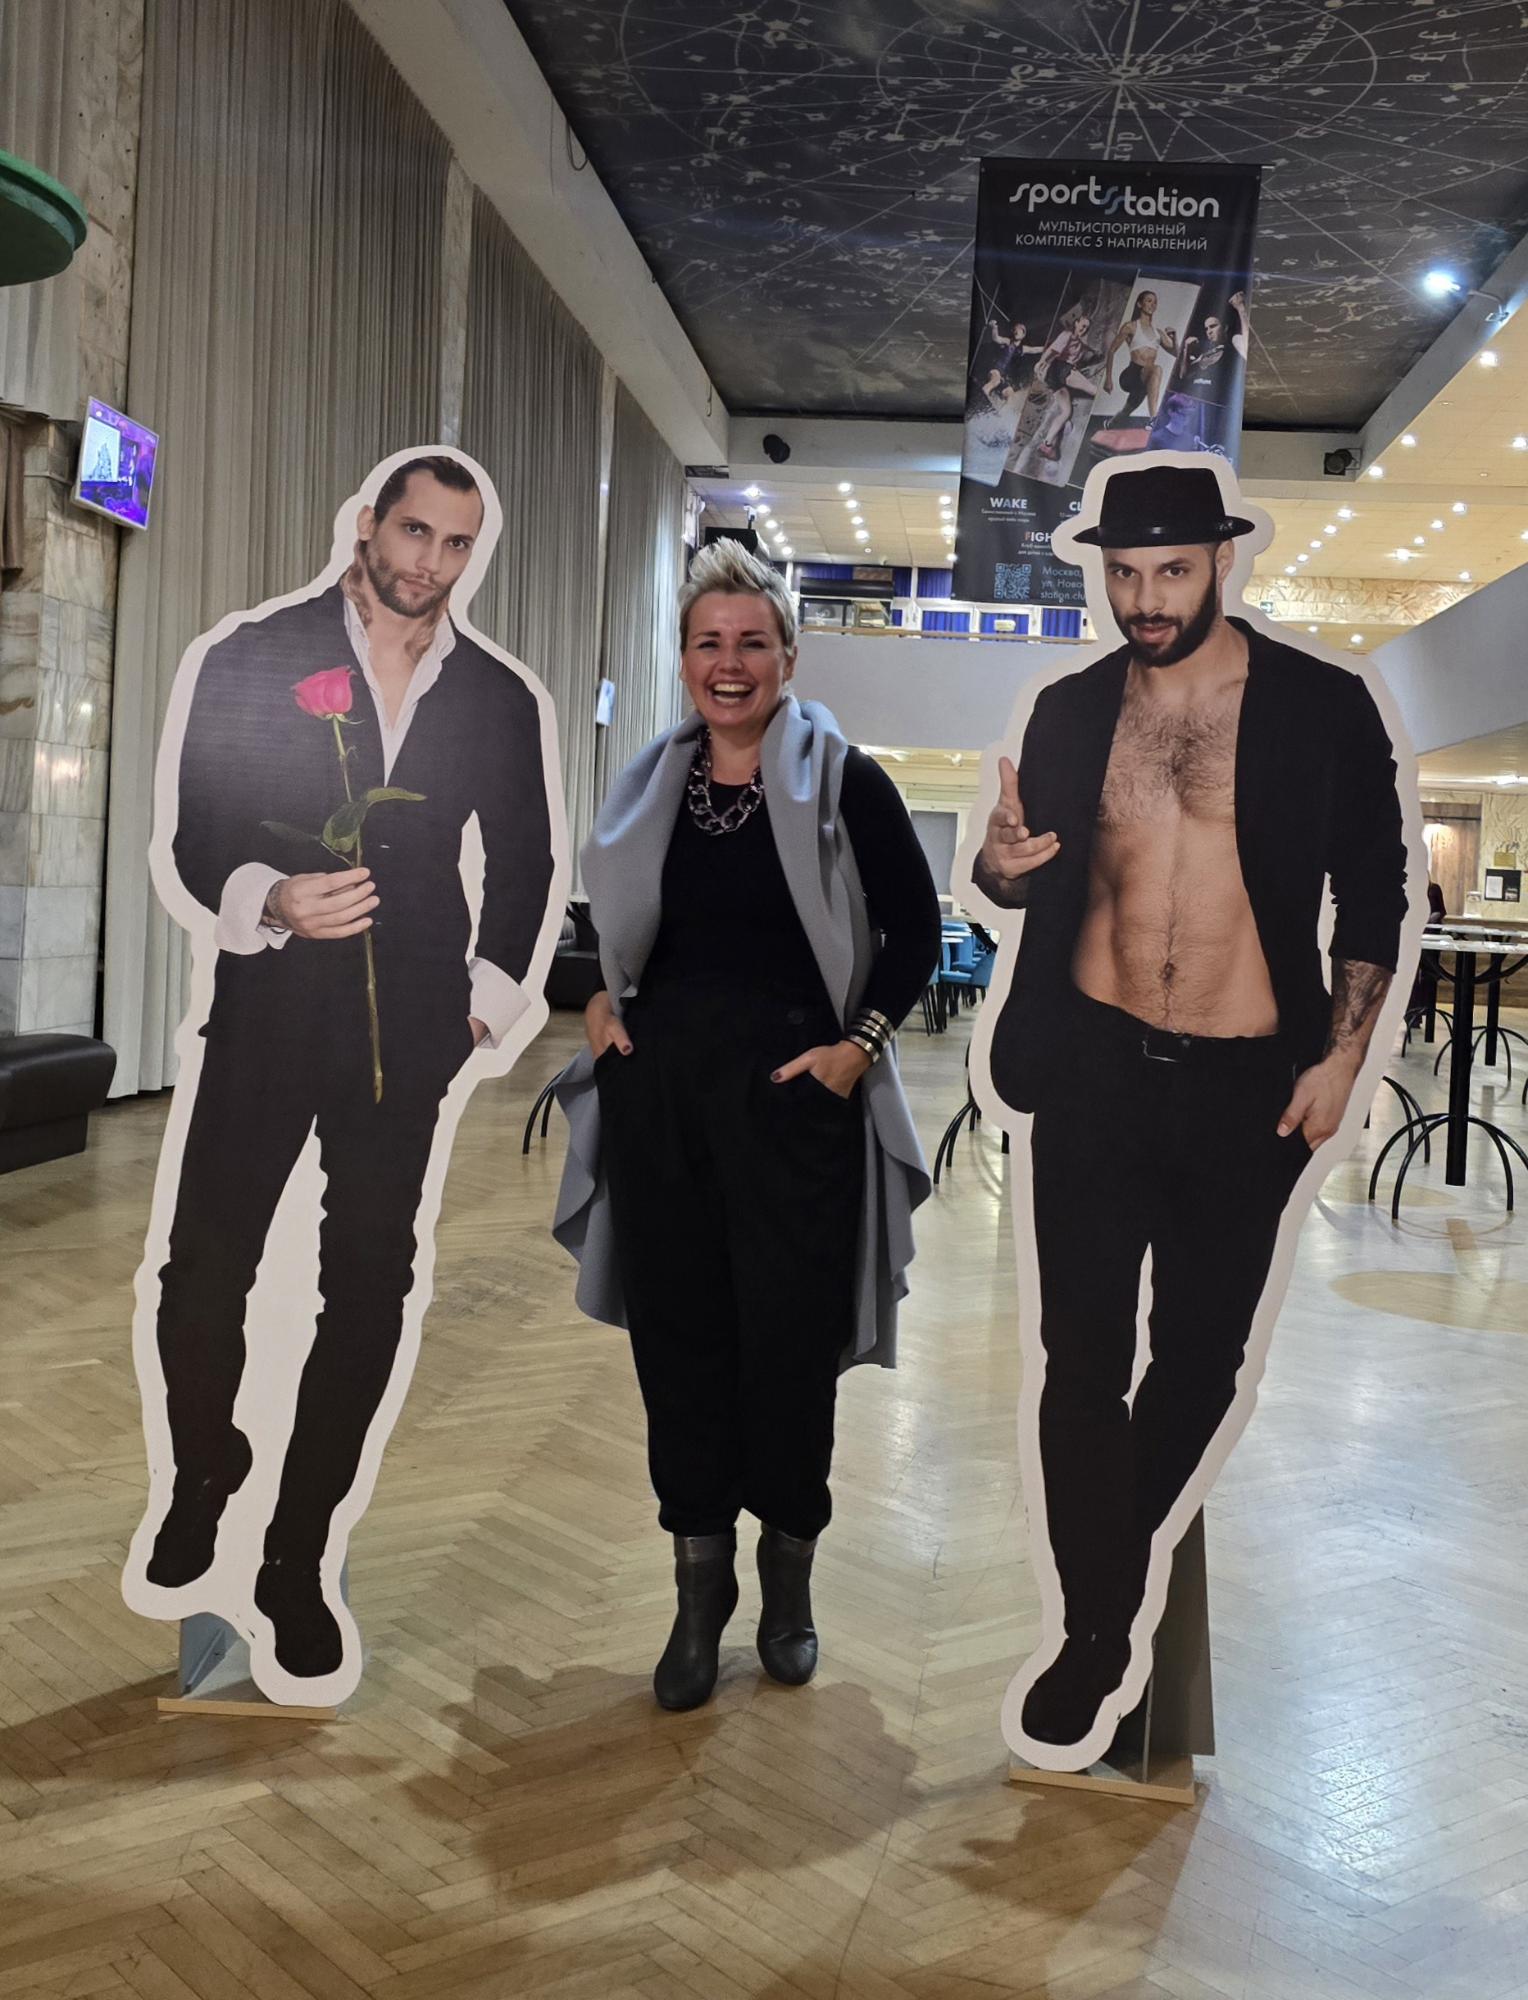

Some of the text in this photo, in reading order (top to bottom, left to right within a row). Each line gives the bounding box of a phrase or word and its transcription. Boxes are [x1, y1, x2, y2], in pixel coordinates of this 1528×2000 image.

[1038, 220, 1186, 235] МУЛЬТИСПОРТИВНЫЙ
[1015, 234, 1208, 251] КОМПЛЕКС 5 НАПРАВЛЕНИЙ
[990, 497, 1082, 511] WAKE CL
[1024, 531, 1053, 542] FIGH
[1042, 566, 1083, 578] Москва,
[1057, 579, 1084, 588] Ново
[1040, 591, 1086, 601] station.clu
